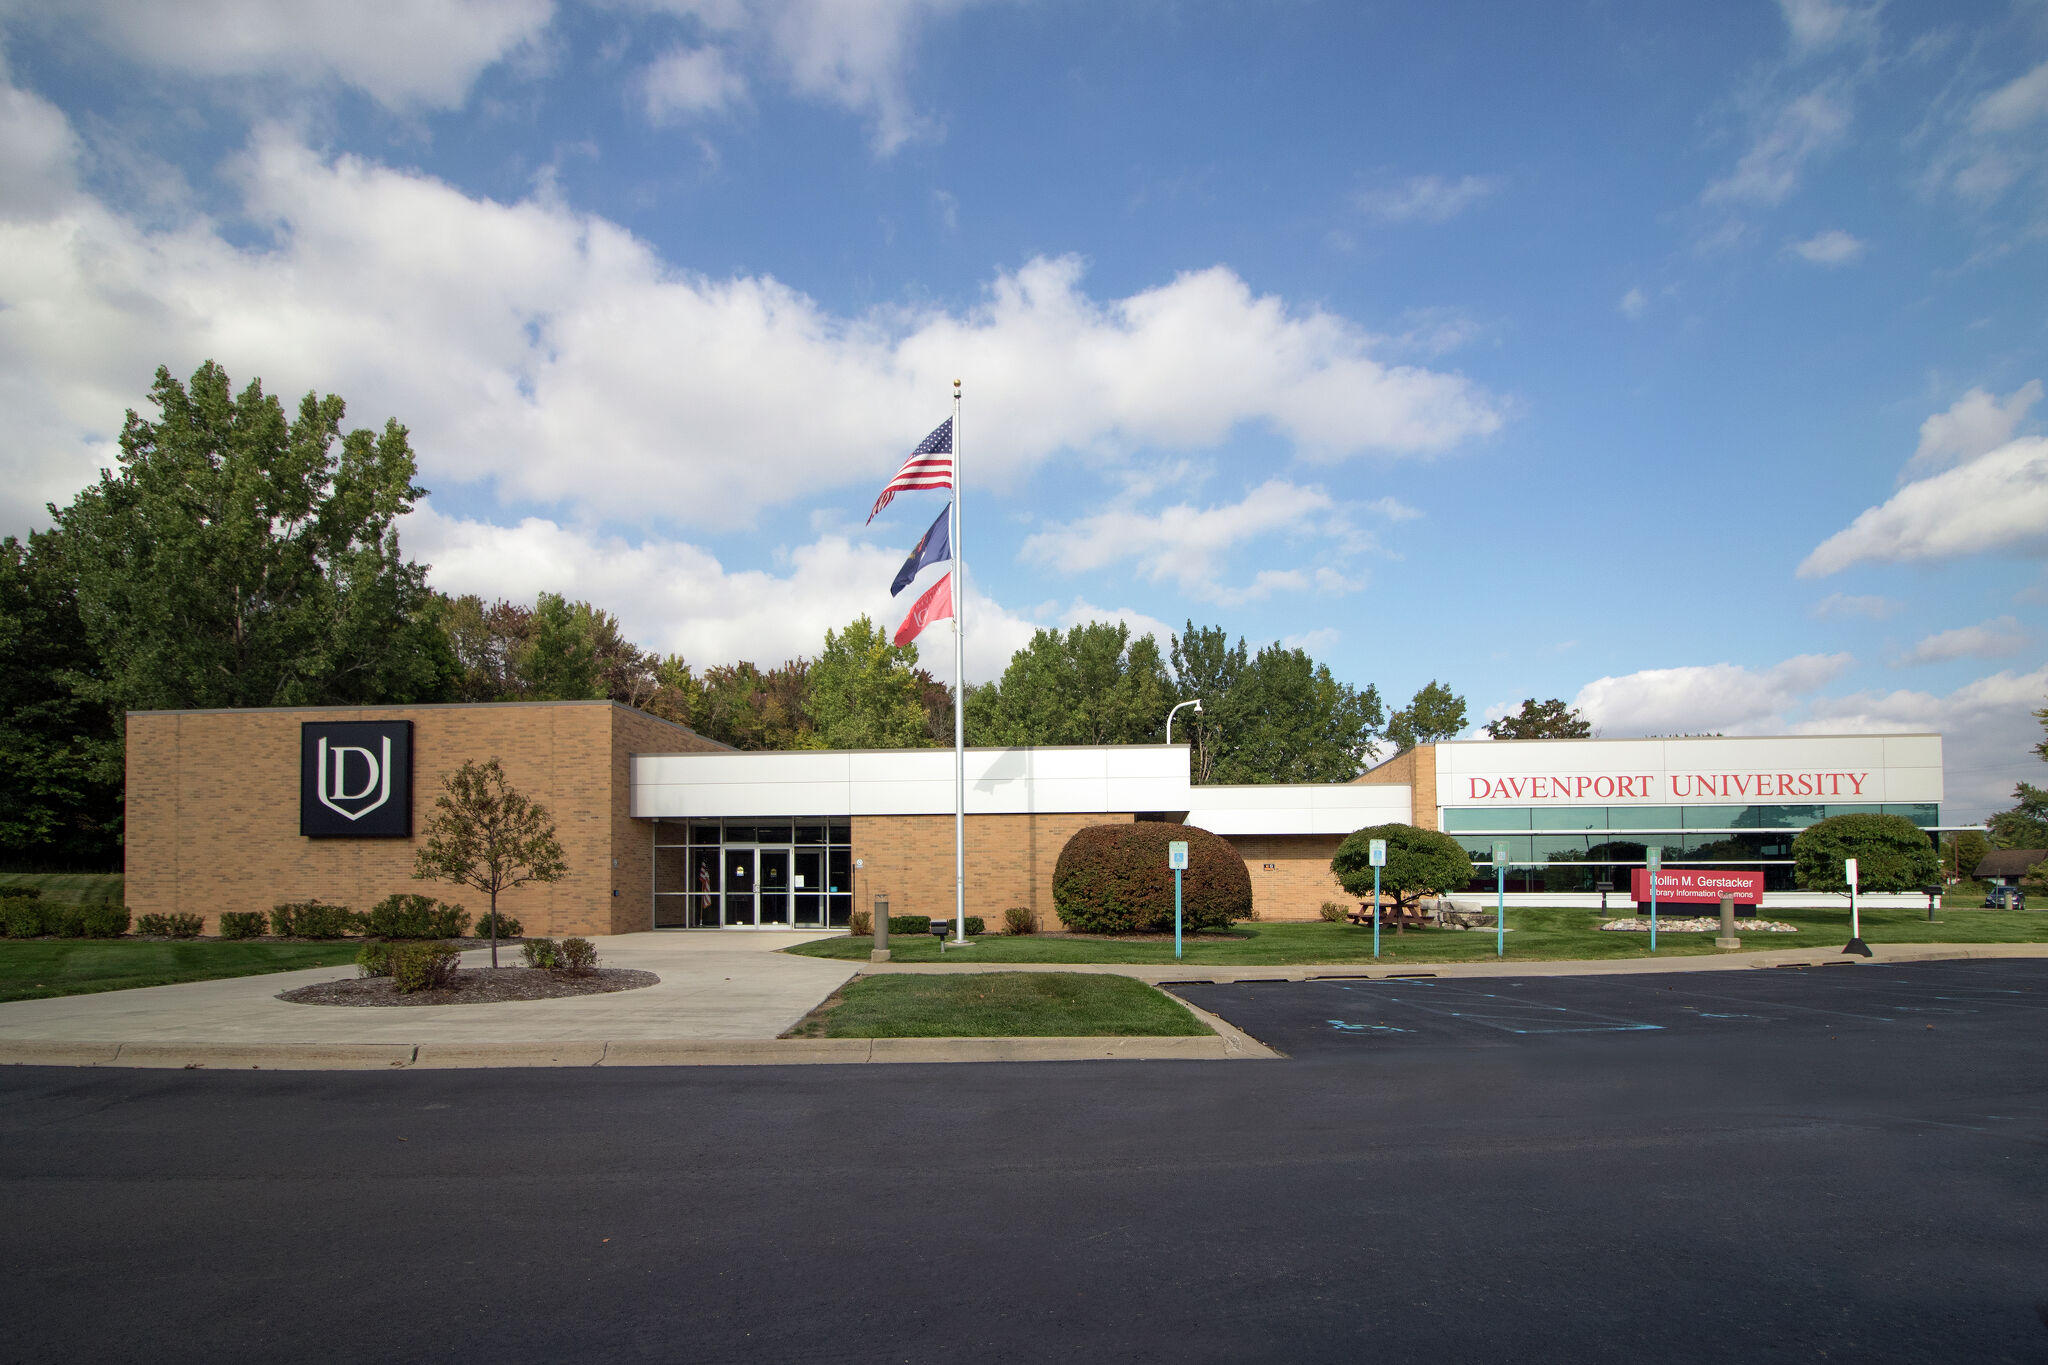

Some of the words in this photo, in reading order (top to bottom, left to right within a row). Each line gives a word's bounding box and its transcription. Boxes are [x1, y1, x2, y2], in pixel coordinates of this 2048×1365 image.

[1468, 775, 1655, 799] DAVENPORT
[1669, 772, 1869, 797] UNIVERSITY
[1681, 875, 1695, 886] M.
[1697, 876, 1754, 888] Gerstacker
[1676, 888, 1716, 898] Information
[1717, 889, 1754, 899] Cmons
